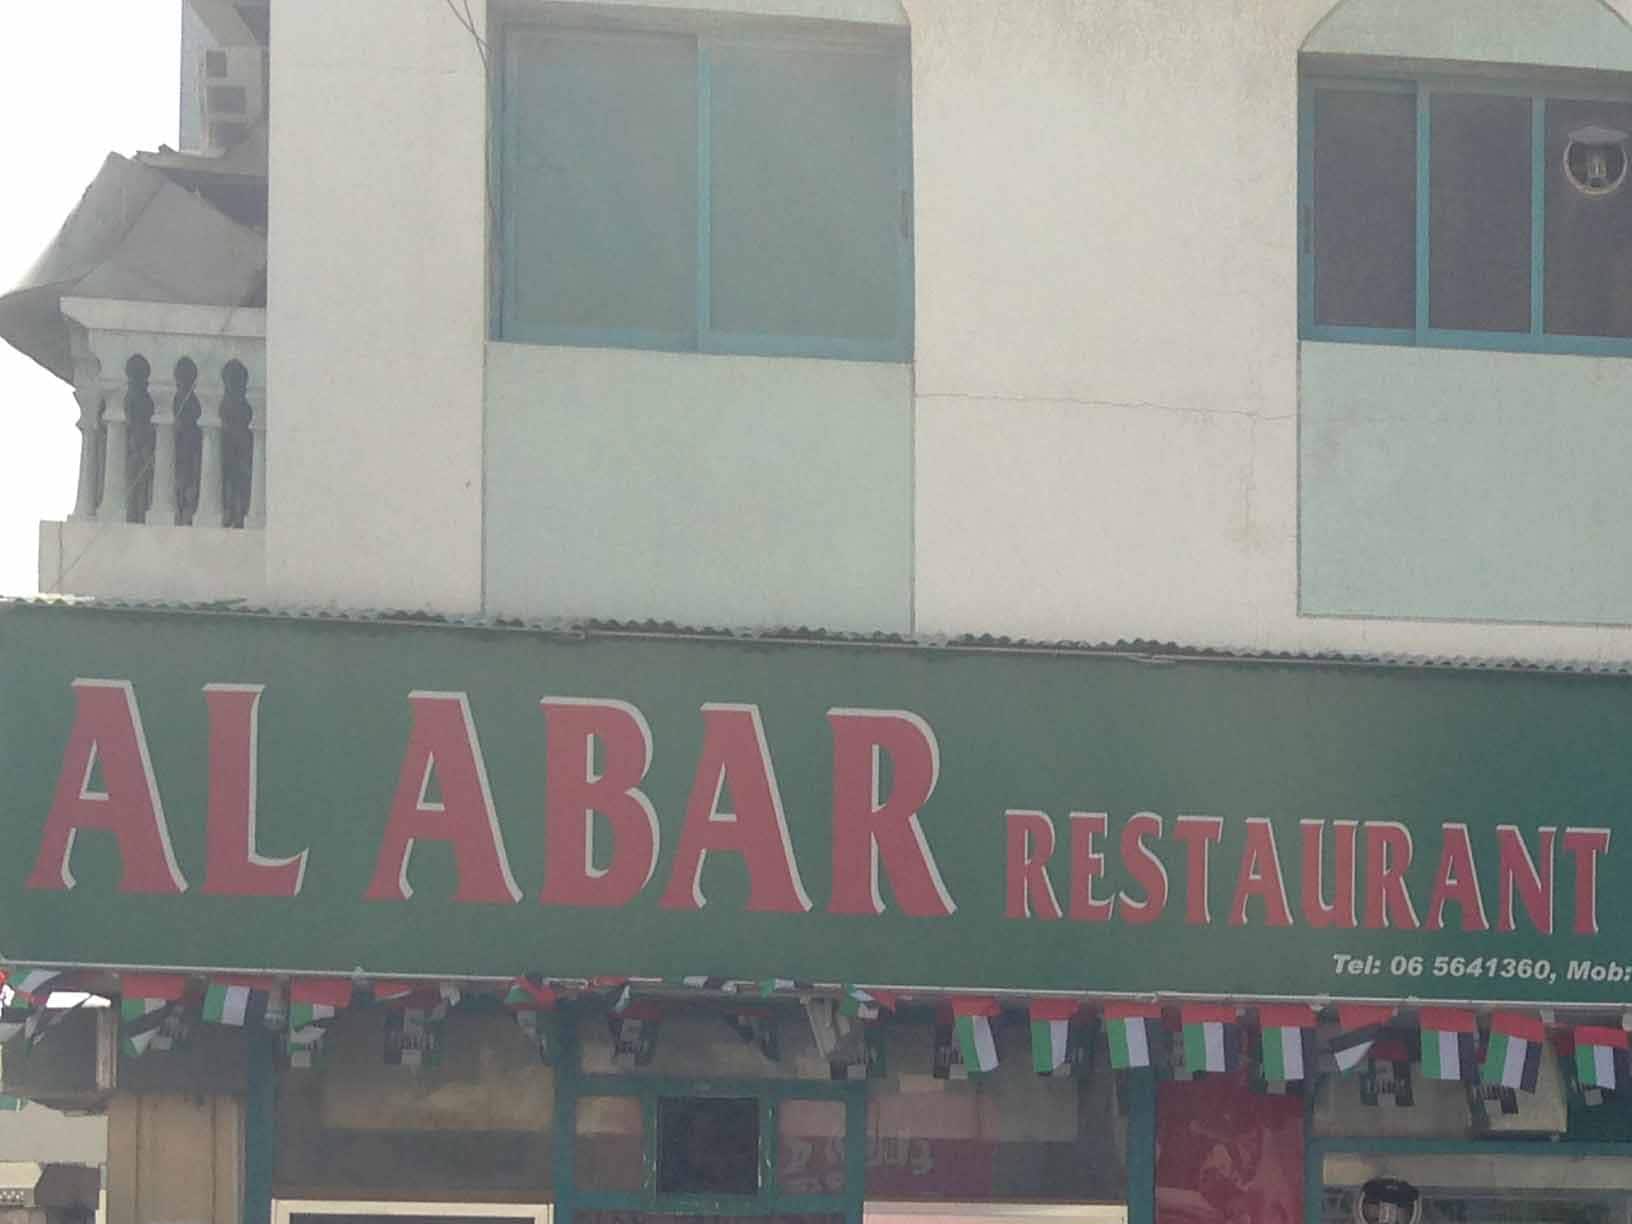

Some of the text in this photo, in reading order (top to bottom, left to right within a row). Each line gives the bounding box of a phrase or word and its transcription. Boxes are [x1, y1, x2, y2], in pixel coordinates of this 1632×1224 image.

[25, 677, 1612, 936] AL ABAR RESTAURANT
[1333, 953, 1381, 976] Tel:
[1390, 955, 1424, 977] 06
[1432, 956, 1557, 984] 5641360,
[1566, 959, 1632, 983] Mob:
